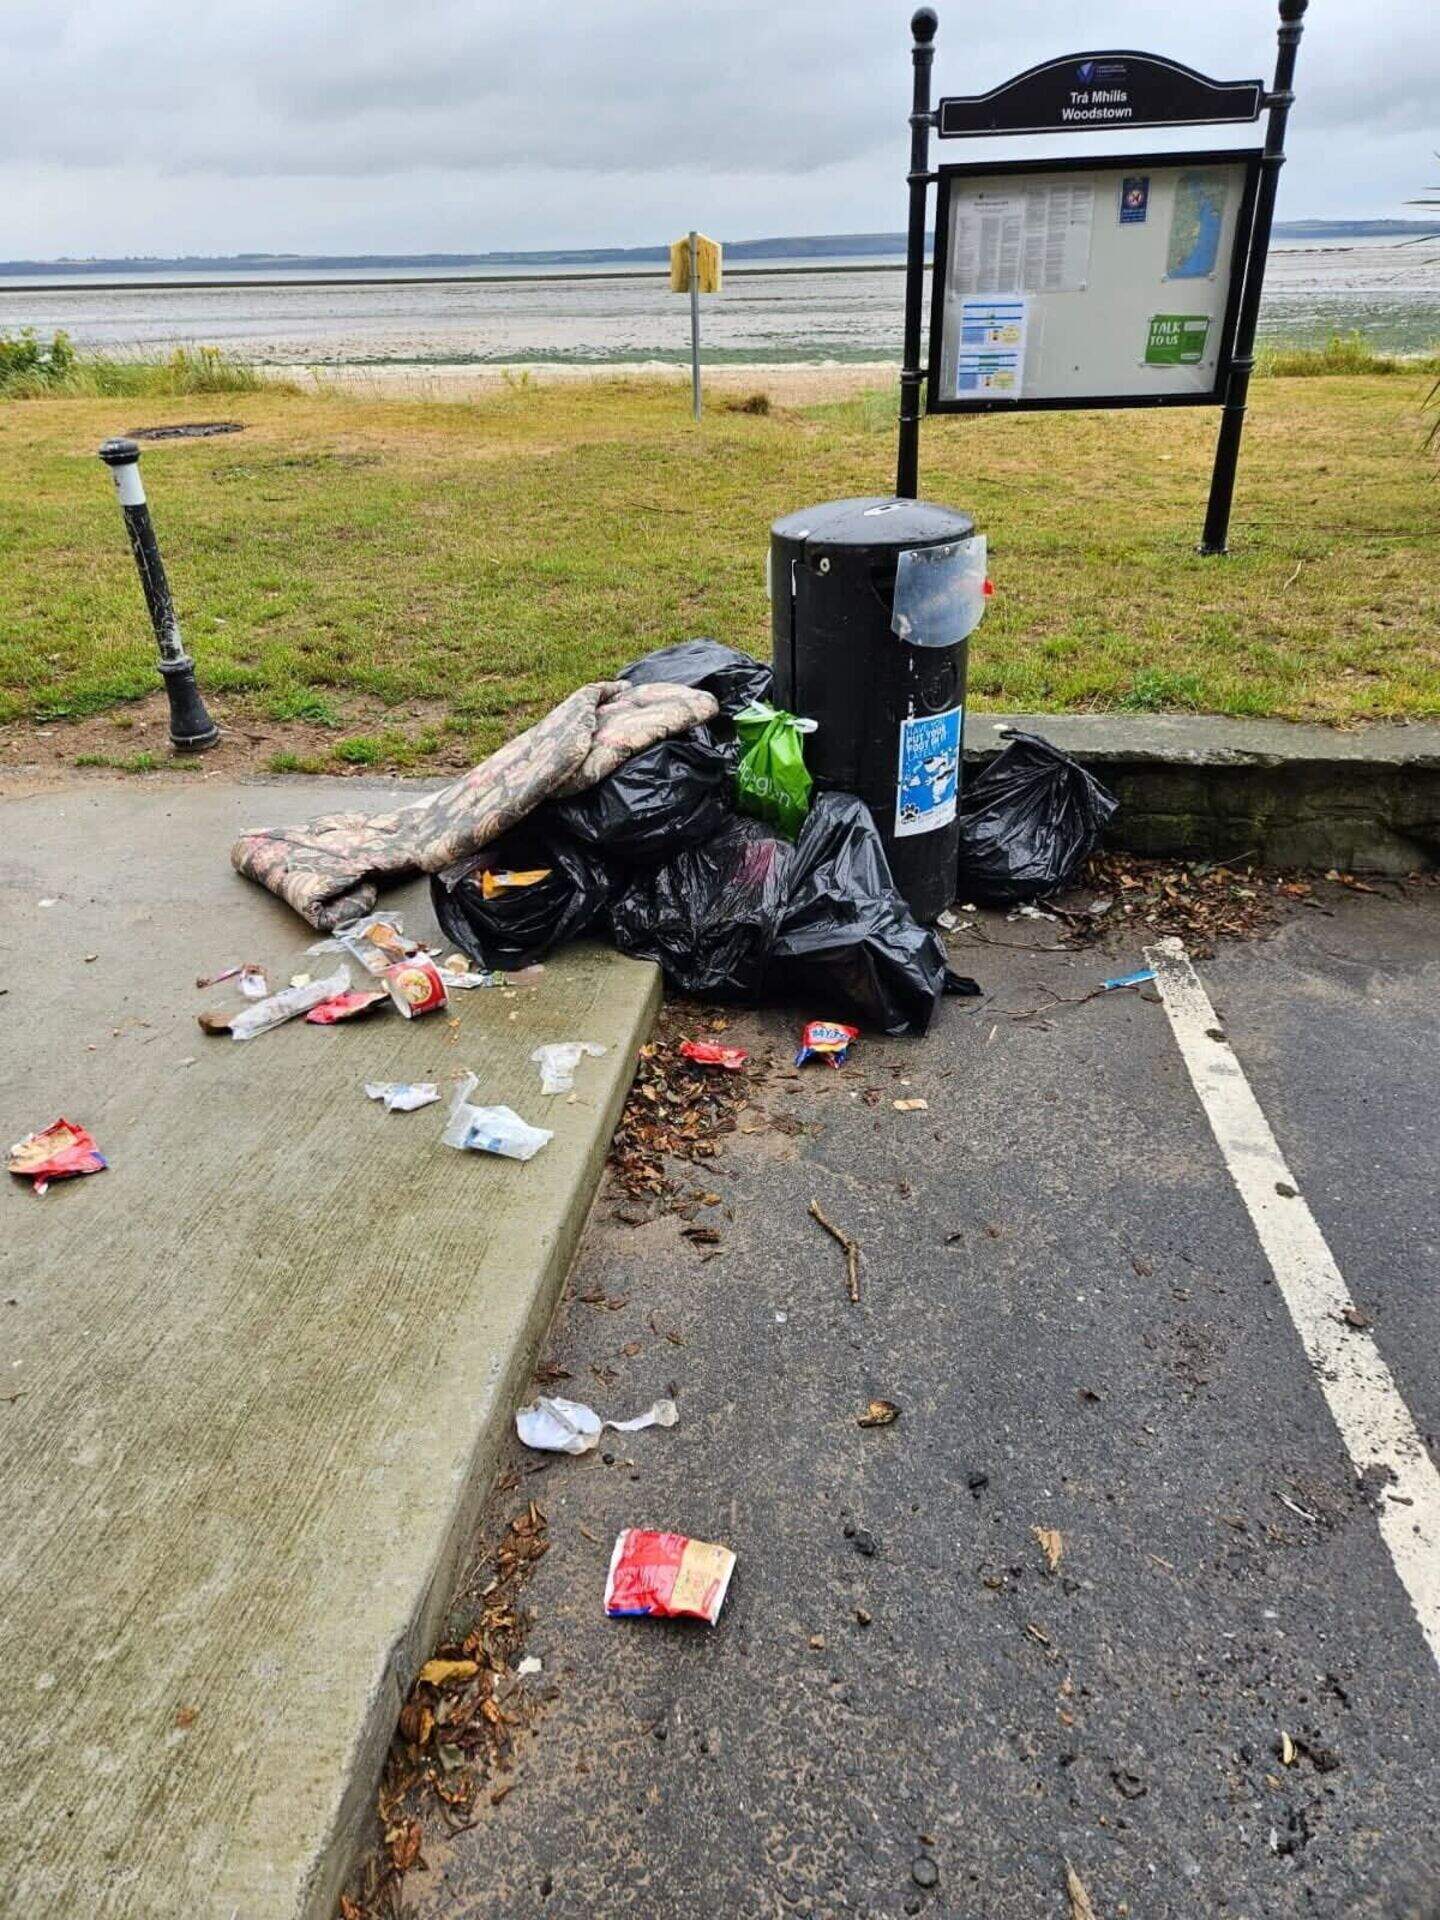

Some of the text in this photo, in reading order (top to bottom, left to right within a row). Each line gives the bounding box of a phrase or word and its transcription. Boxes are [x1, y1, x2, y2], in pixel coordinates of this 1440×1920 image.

[1062, 107, 1132, 121] Woodstown
[1152, 321, 1181, 334] TALK
[1150, 335, 1178, 346] TO US
